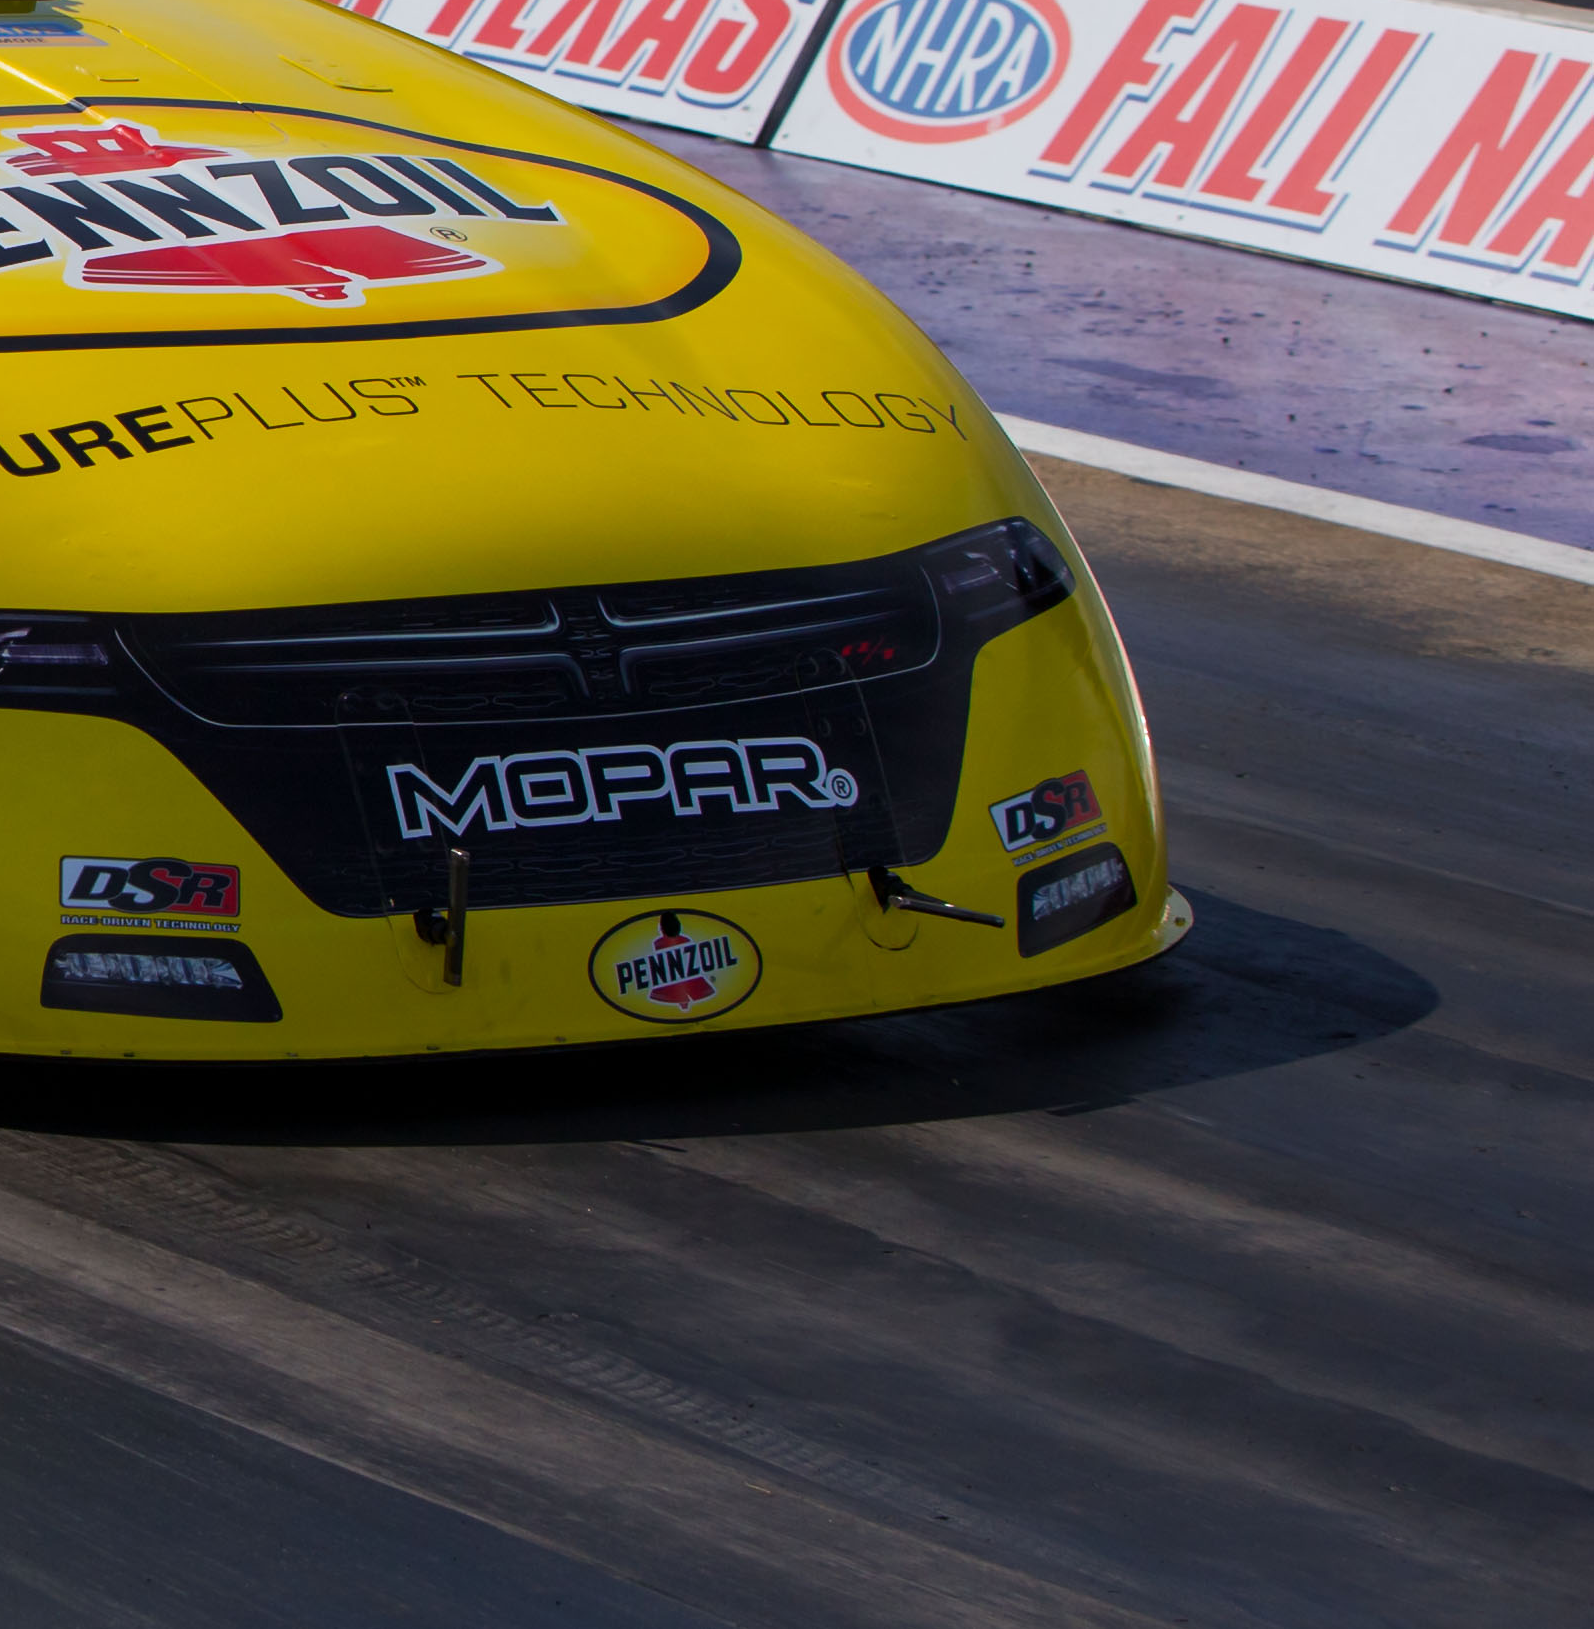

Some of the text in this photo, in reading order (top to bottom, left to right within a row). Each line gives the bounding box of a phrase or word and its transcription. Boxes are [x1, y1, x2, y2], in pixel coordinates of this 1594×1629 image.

[457, 372, 968, 446] TECHNOLOGY
[386, 736, 834, 839] MOPAR
[1005, 777, 1092, 846] DSR
[68, 857, 232, 914] DSR
[155, 918, 242, 934] TECHNOLOGY
[615, 935, 739, 996] PENNZOIL
